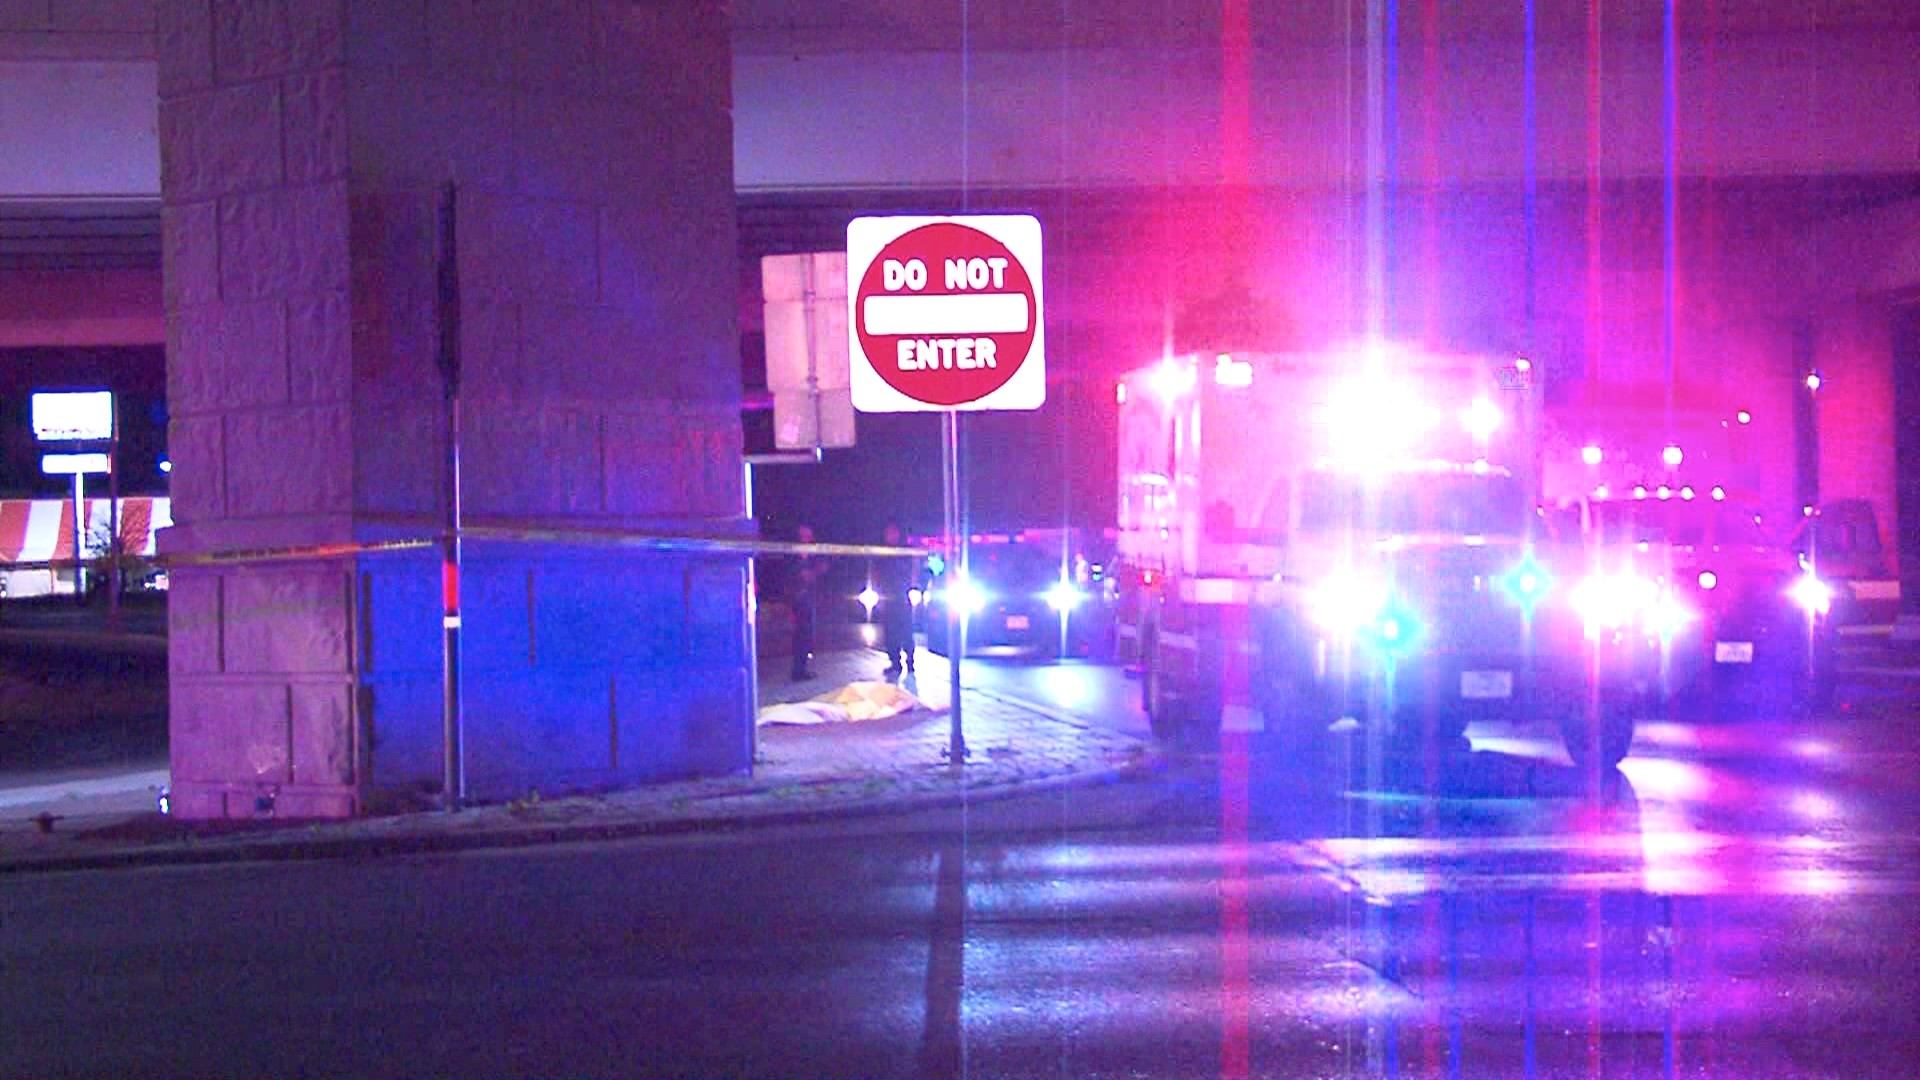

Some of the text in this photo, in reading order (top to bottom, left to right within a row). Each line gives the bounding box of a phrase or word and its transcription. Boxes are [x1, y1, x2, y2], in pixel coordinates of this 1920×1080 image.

[883, 257, 1008, 291] DO NOT
[897, 337, 997, 370] ENTER
